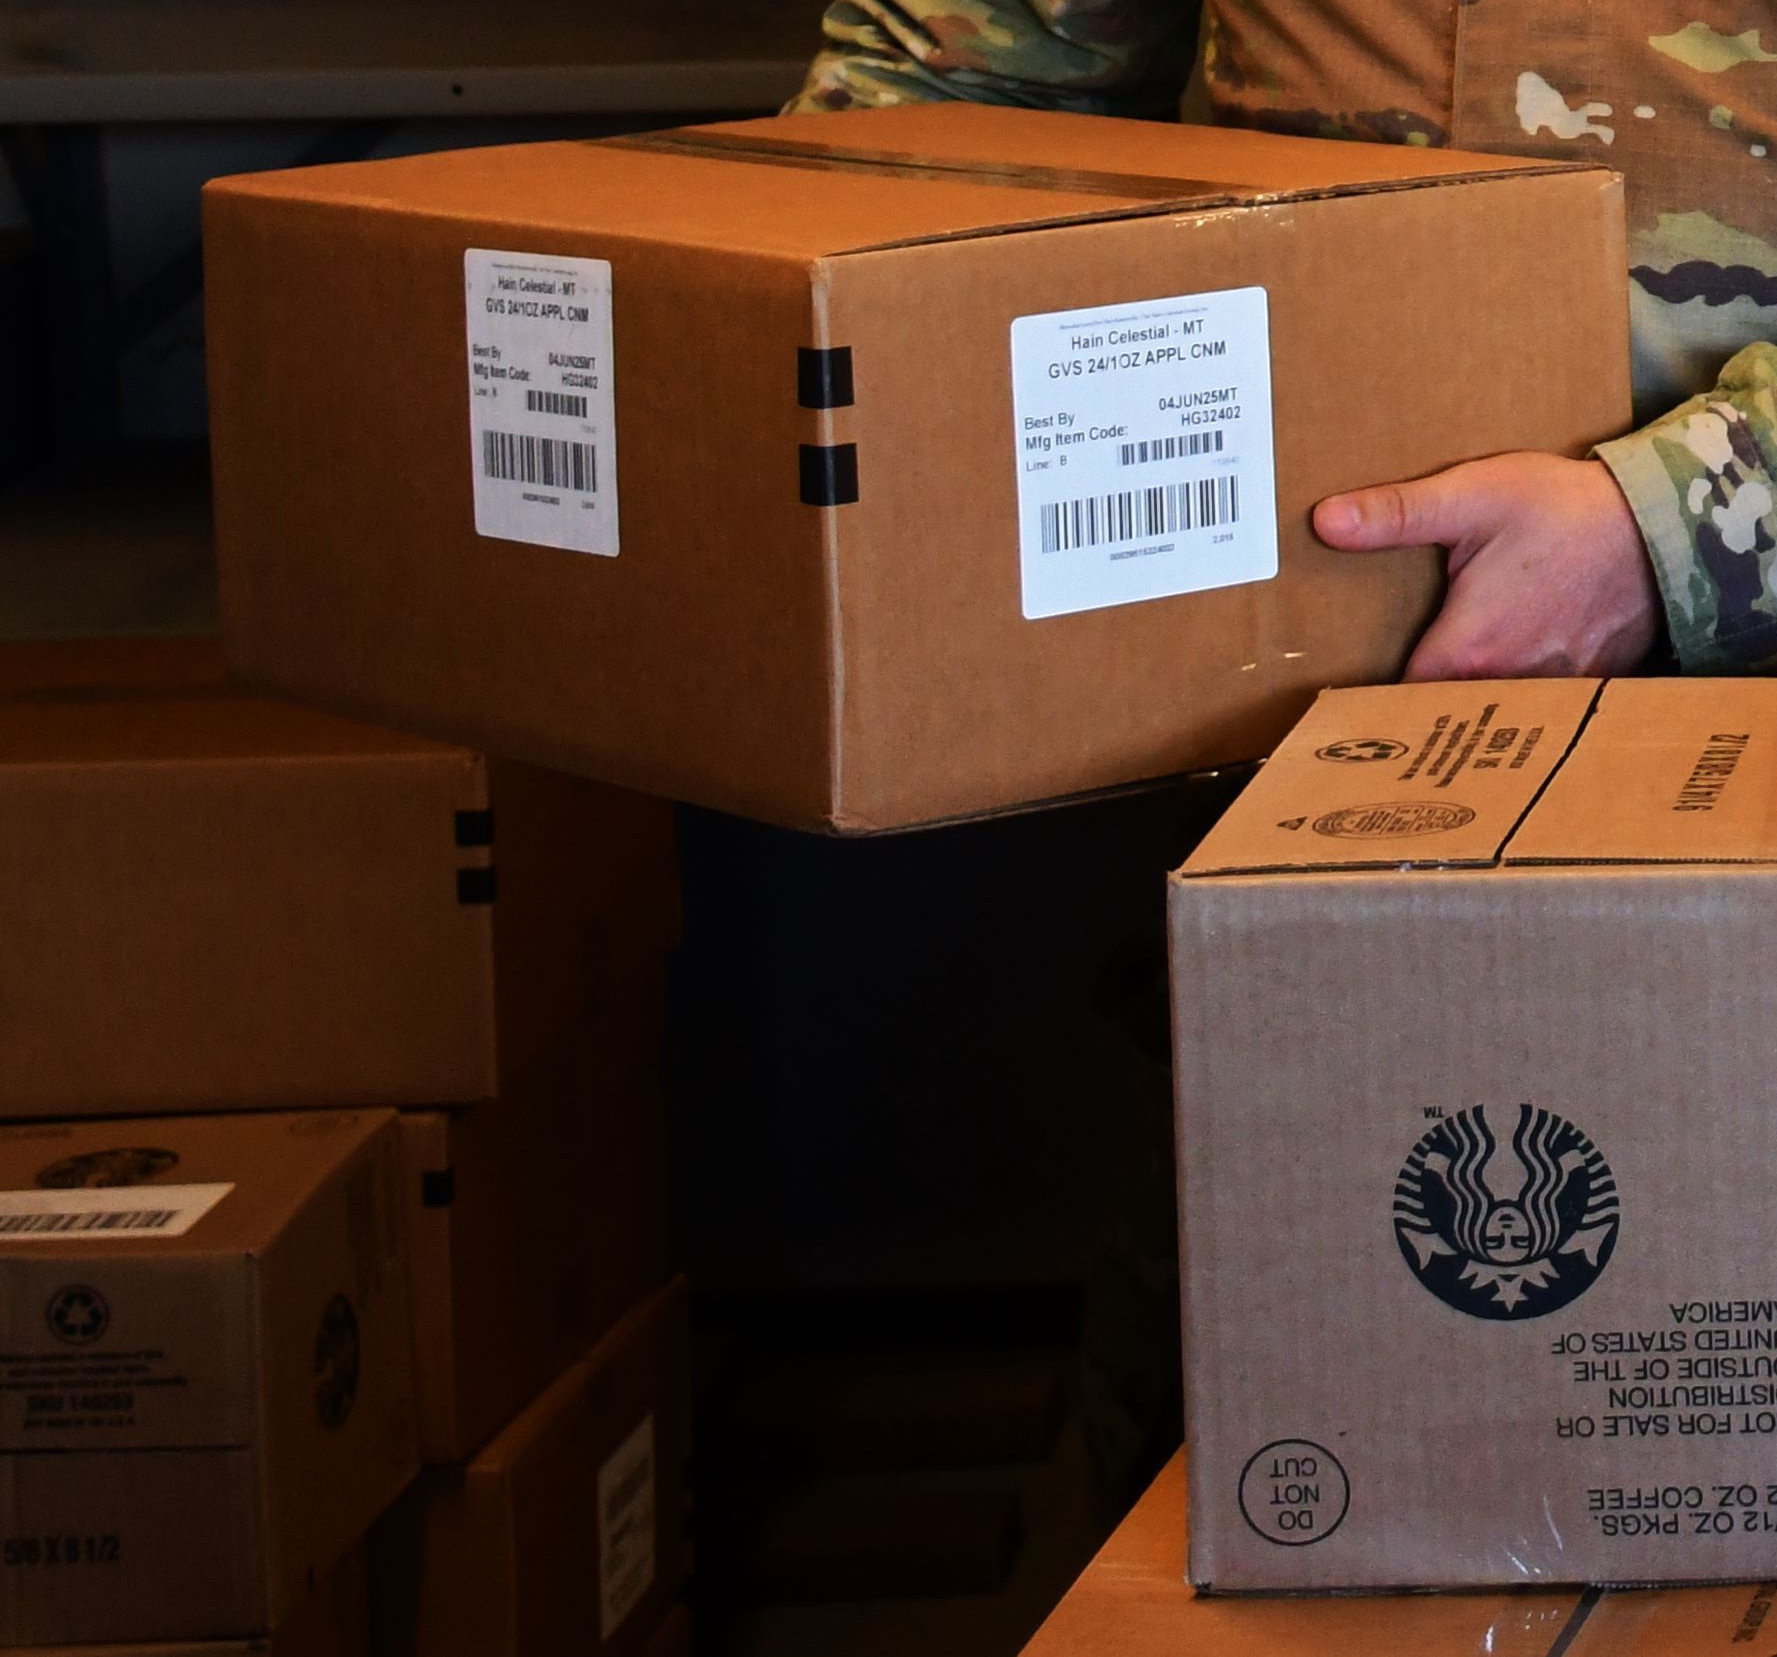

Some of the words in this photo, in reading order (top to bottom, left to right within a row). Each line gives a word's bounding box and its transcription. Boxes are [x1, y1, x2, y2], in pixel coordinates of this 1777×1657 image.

[1071, 334, 1104, 351] Hain
[1108, 324, 1170, 346] Celestial
[1183, 319, 1205, 336] MT
[1048, 360, 1083, 379] GVS
[1145, 346, 1186, 366] APPL
[1191, 341, 1226, 359] CNM
[1159, 387, 1239, 412] 04JUN25MT
[1024, 414, 1054, 431] Best
[1058, 412, 1075, 428] By
[1181, 405, 1242, 428] HG32402
[1025, 434, 1052, 452] Mfg
[1055, 429, 1086, 447] Item
[1089, 425, 1129, 441] Code:
[1551, 1332, 1587, 1355] OF
[1592, 1330, 1687, 1354] STATES
[1574, 1360, 1626, 1382] THE
[1634, 1358, 1670, 1381] OF
[1556, 1416, 1595, 1439] OR
[1603, 1414, 1670, 1437] SALE
[1678, 1413, 1731, 1435] FOR
[1269, 1457, 1318, 1479] CUT
[1269, 1484, 1321, 1505] NOT
[1587, 1486, 1704, 1511] COFFEE
[1711, 1484, 1758, 1508] OZ.
[1277, 1509, 1314, 1531] DO
[1593, 1513, 1680, 1537] PKGS.
[1688, 1511, 1735, 1535] OZ.
